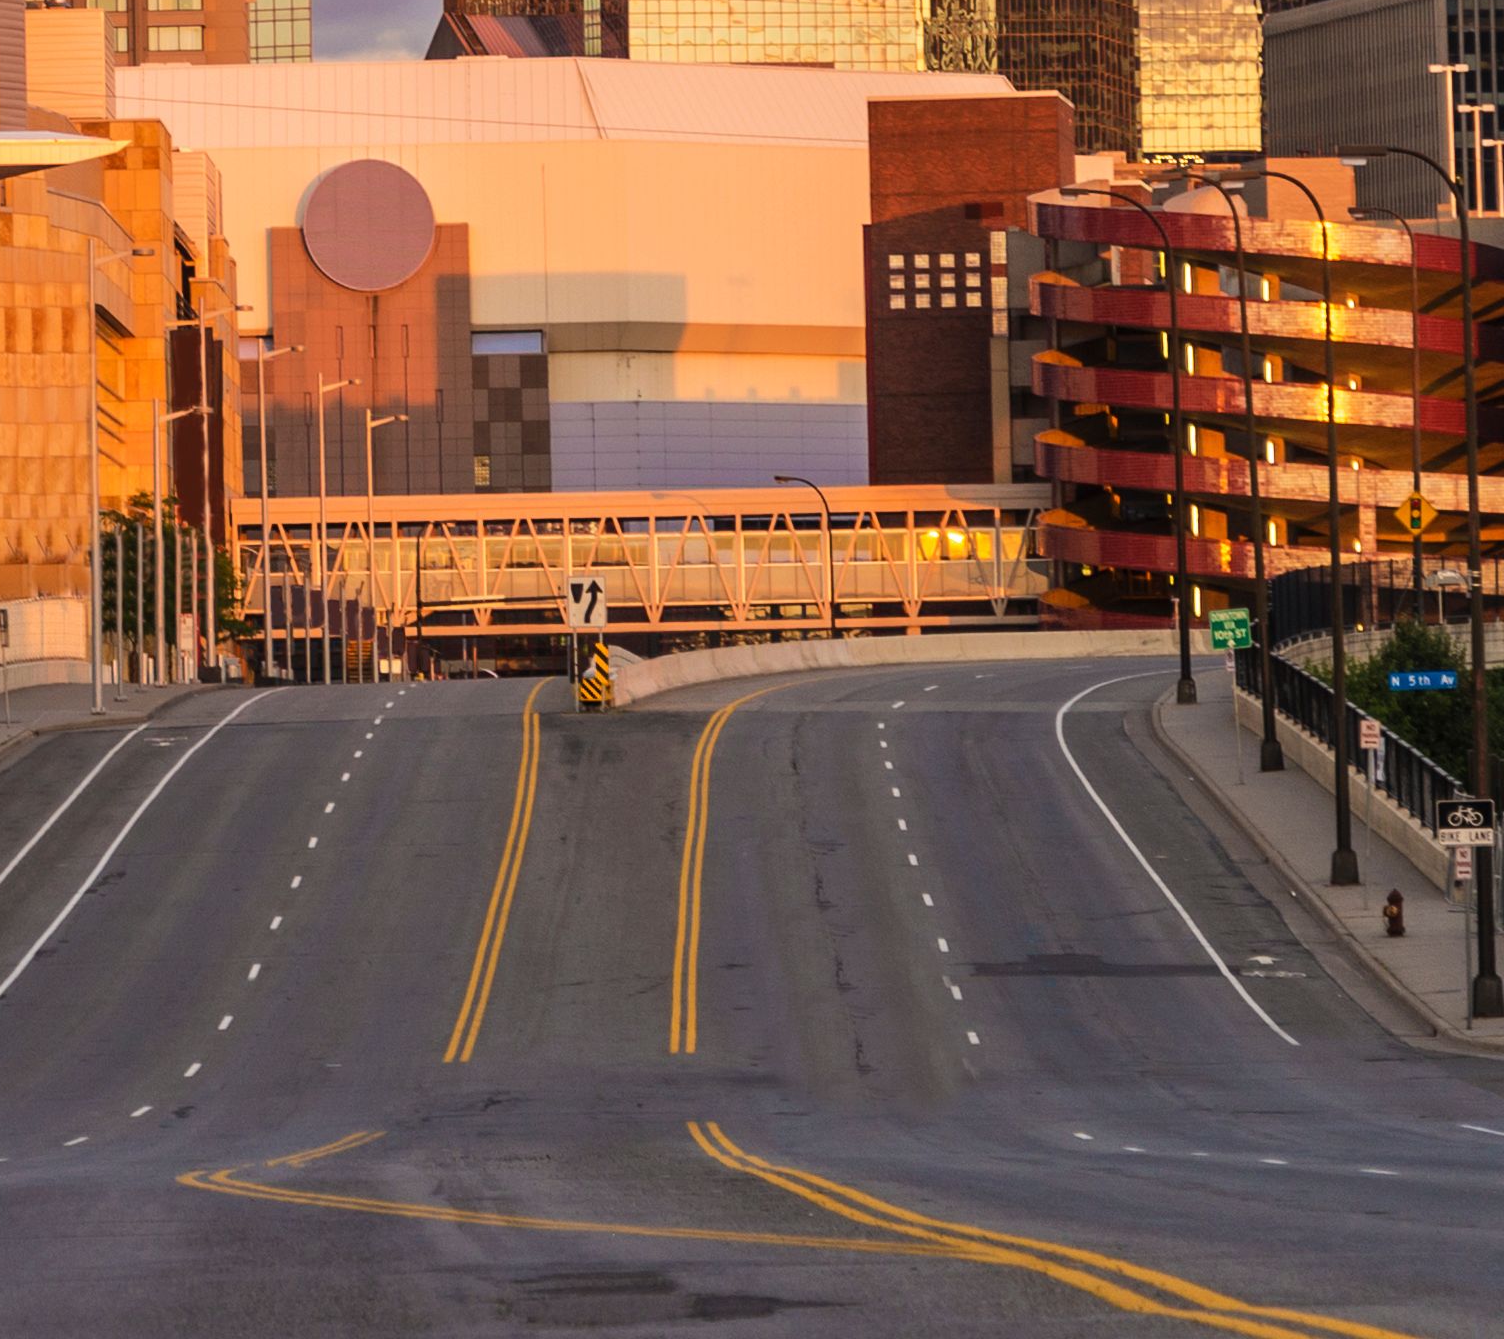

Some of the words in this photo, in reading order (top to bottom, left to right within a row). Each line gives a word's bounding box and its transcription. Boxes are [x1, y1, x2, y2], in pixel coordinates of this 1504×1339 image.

[1391, 675, 1400, 687] N
[1408, 674, 1431, 686] 5th
[1440, 674, 1455, 685] Av
[1440, 831, 1461, 842] BIKE
[1469, 830, 1492, 842] LANE
